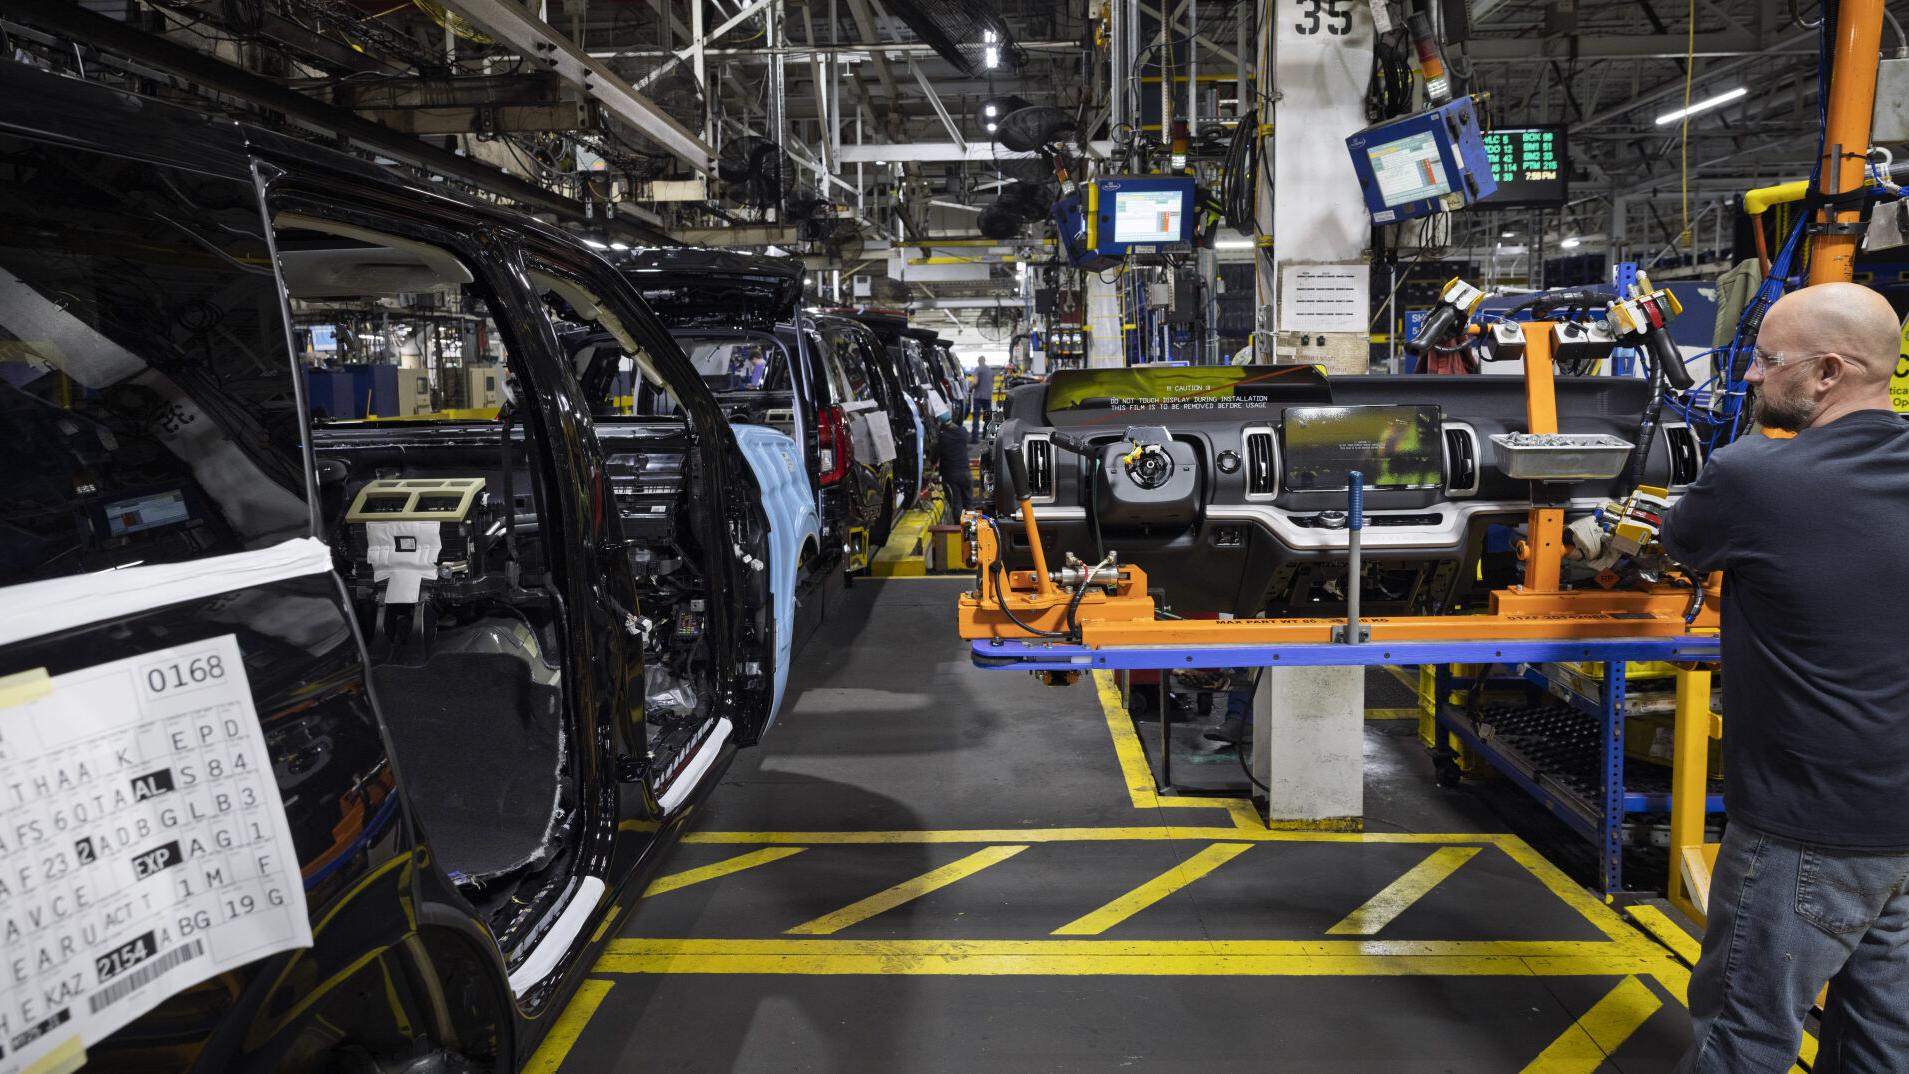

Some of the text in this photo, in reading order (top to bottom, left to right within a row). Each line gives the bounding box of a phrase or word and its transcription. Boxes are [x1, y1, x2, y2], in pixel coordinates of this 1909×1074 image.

[1295, 0, 1352, 35] 35
[148, 655, 225, 692] 0168
[11, 720, 239, 802] T H A A K E P D
[16, 820, 44, 846] FS
[55, 810, 67, 831] 6
[114, 789, 127, 808] A
[134, 776, 168, 801] AL
[180, 766, 196, 785] S
[208, 759, 223, 777] 8
[235, 753, 247, 770] 4
[6, 822, 264, 941] A V C E EXP A G 1
[19, 865, 31, 889] F
[42, 852, 68, 879] 23
[77, 841, 96, 866] 2
[136, 818, 151, 837] B
[161, 808, 177, 828] G
[189, 802, 205, 819] L
[216, 794, 232, 812] B
[241, 788, 256, 806] 3
[13, 958, 27, 982] E
[38, 948, 53, 969] A
[60, 936, 74, 957] R
[82, 924, 97, 945] U
[105, 902, 133, 930] ACT
[179, 879, 194, 897] 1
[205, 868, 223, 888] M
[258, 855, 270, 874] F
[21, 998, 36, 1023] E
[44, 973, 84, 1010] KAZ
[98, 938, 149, 981] 2154
[160, 928, 172, 947] A
[178, 910, 211, 937] BG
[226, 895, 255, 919] 19
[268, 888, 284, 906] G
